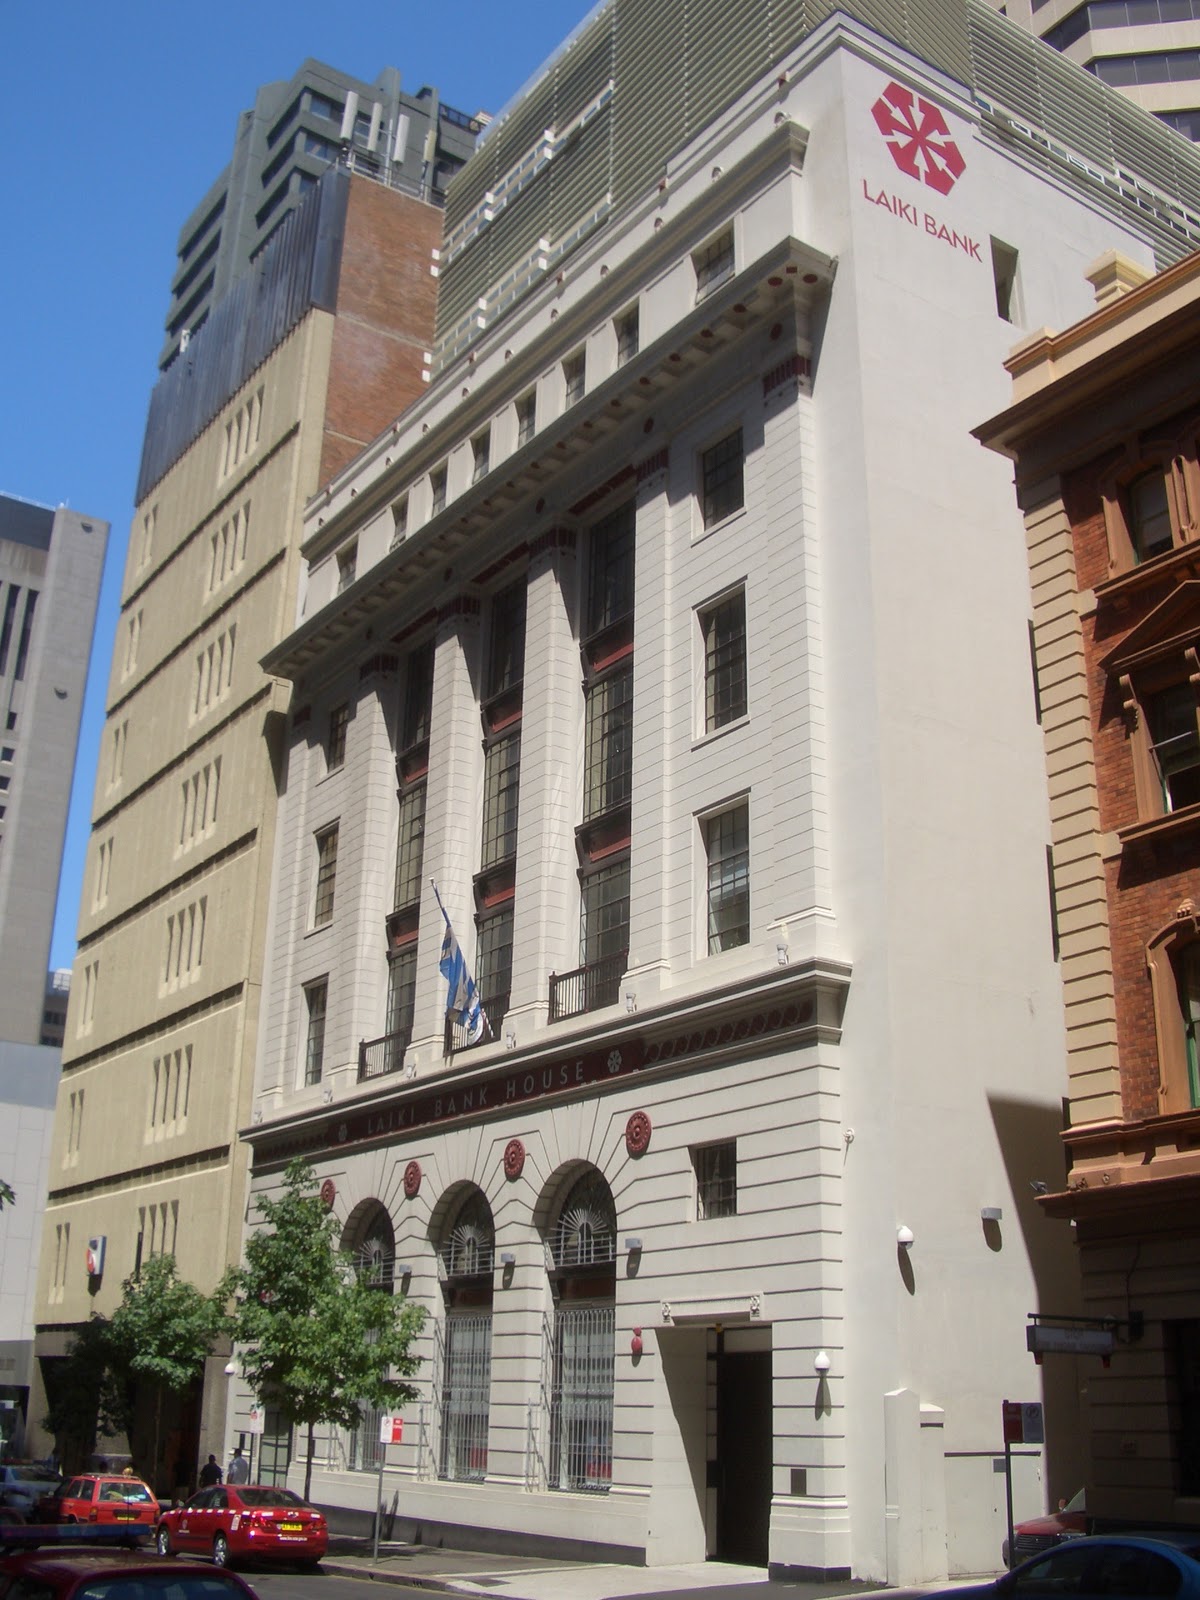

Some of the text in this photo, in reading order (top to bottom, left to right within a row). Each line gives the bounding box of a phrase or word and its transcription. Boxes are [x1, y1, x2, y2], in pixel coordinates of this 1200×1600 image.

[863, 178, 983, 263] LAIKI BANK
[367, 1060, 584, 1135] LAIKI BANK HOUSE
